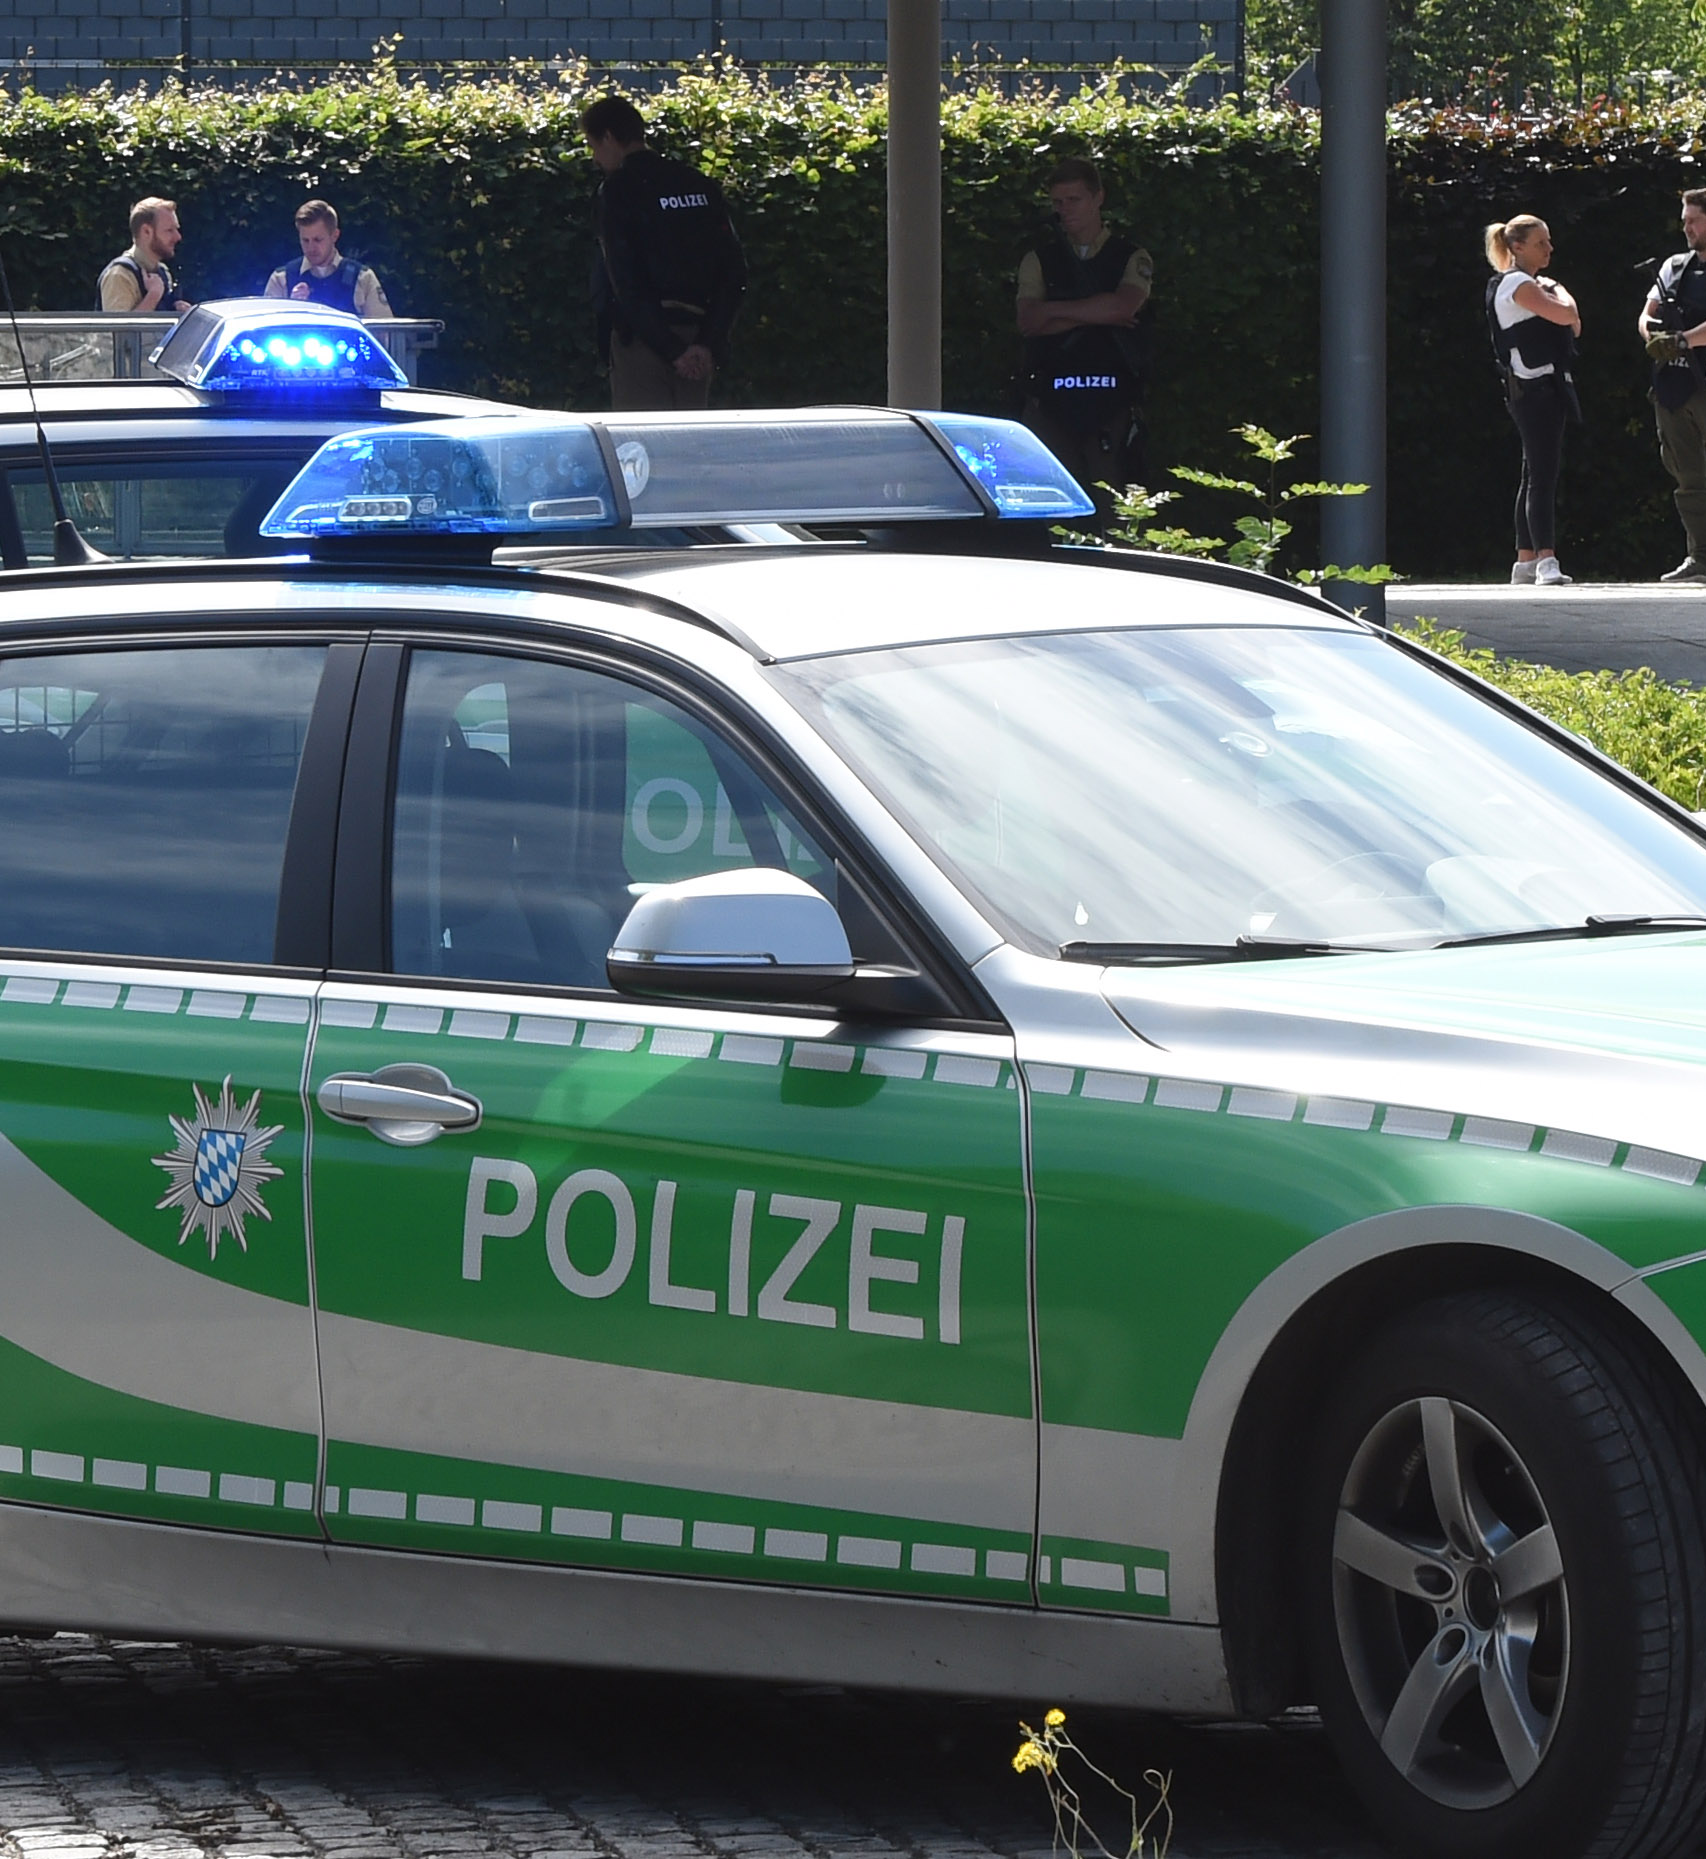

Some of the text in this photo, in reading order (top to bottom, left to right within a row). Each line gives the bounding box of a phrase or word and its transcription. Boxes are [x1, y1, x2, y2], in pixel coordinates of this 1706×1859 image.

[659, 194, 709, 210] POLIZEI
[1054, 375, 1116, 390] POLIZEI
[462, 1156, 965, 1345] POLIZEI
